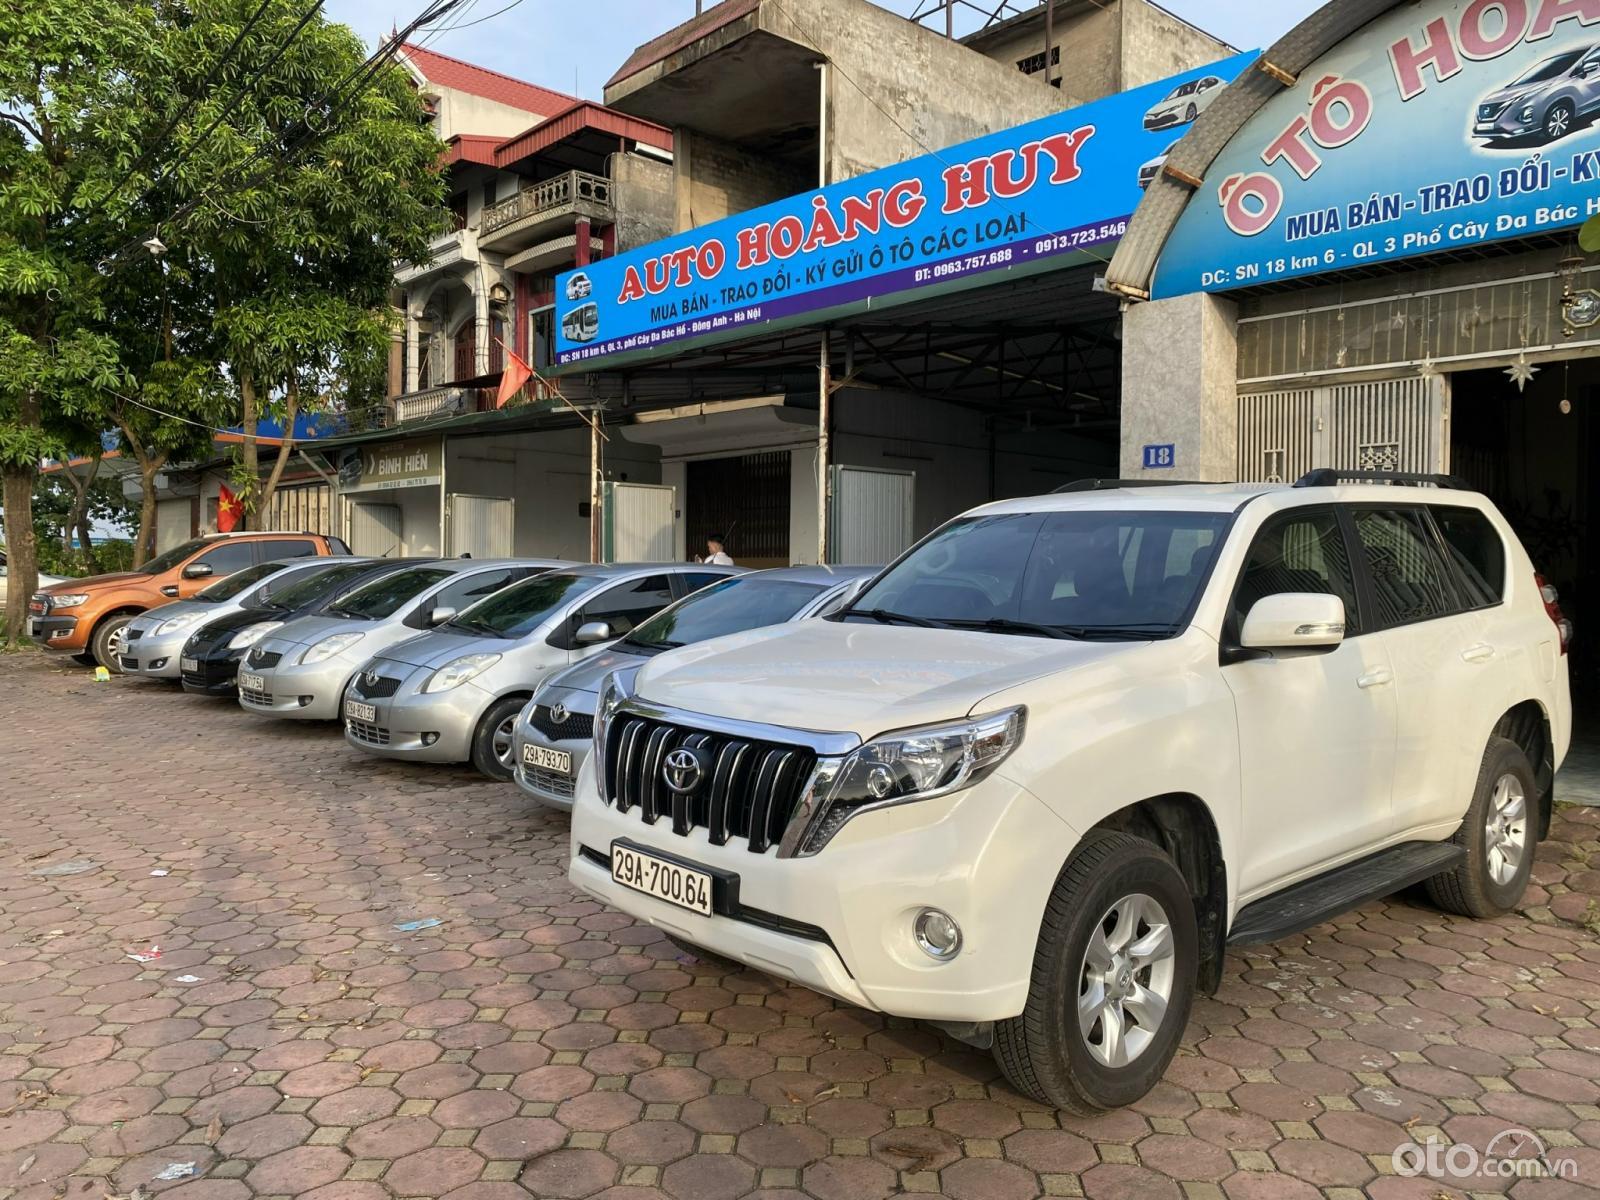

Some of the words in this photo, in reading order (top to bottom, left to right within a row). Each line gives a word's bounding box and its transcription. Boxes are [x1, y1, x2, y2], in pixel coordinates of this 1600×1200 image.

[1218, 172, 1283, 236] Ô
[1261, 71, 1374, 181] TÔ
[617, 239, 725, 304] AUTO
[736, 178, 926, 270] HOÀNG
[942, 125, 1095, 214] HUY
[1285, 208, 1340, 242] MUA
[1346, 190, 1400, 229] BÁN
[1419, 174, 1491, 214] TRAO
[1499, 153, 1550, 198] ĐỔI
[651, 302, 678, 323] MUA
[682, 291, 708, 315] BÁN
[720, 282, 758, 305] TRAO
[763, 263, 791, 294] ĐỔI
[806, 258, 826, 284] KÝ
[869, 244, 883, 269] Ô
[889, 237, 914, 265] TÔ
[921, 226, 968, 256] CÁC
[975, 212, 1026, 244] LOẠI
[914, 268, 931, 282] ĐT:
[934, 248, 1012, 277] 0963.757.688
[1035, 221, 1126, 254] 0913.723.546
[1201, 271, 1229, 287] ĐC:
[1236, 264, 1259, 281] SN
[1266, 258, 1286, 274] 18
[1291, 253, 1317, 272] km
[1324, 249, 1335, 264] 6
[1352, 241, 1378, 259] QL
[1384, 237, 1396, 253] 3
[1403, 223, 1442, 249] Phố
[1448, 220, 1489, 239] Cây
[1496, 214, 1527, 232] Đa
[1535, 204, 1578, 225] Bác
[572, 351, 580, 361] SN
[581, 349, 589, 358] 18
[590, 346, 599, 356] km
[607, 343, 615, 353] QL
[713, 316, 727, 327] Anh
[734, 310, 745, 322] Hà
[747, 308, 761, 320] Nội
[1148, 447, 1170, 465] 18
[615, 850, 708, 910] 29A-700.64
